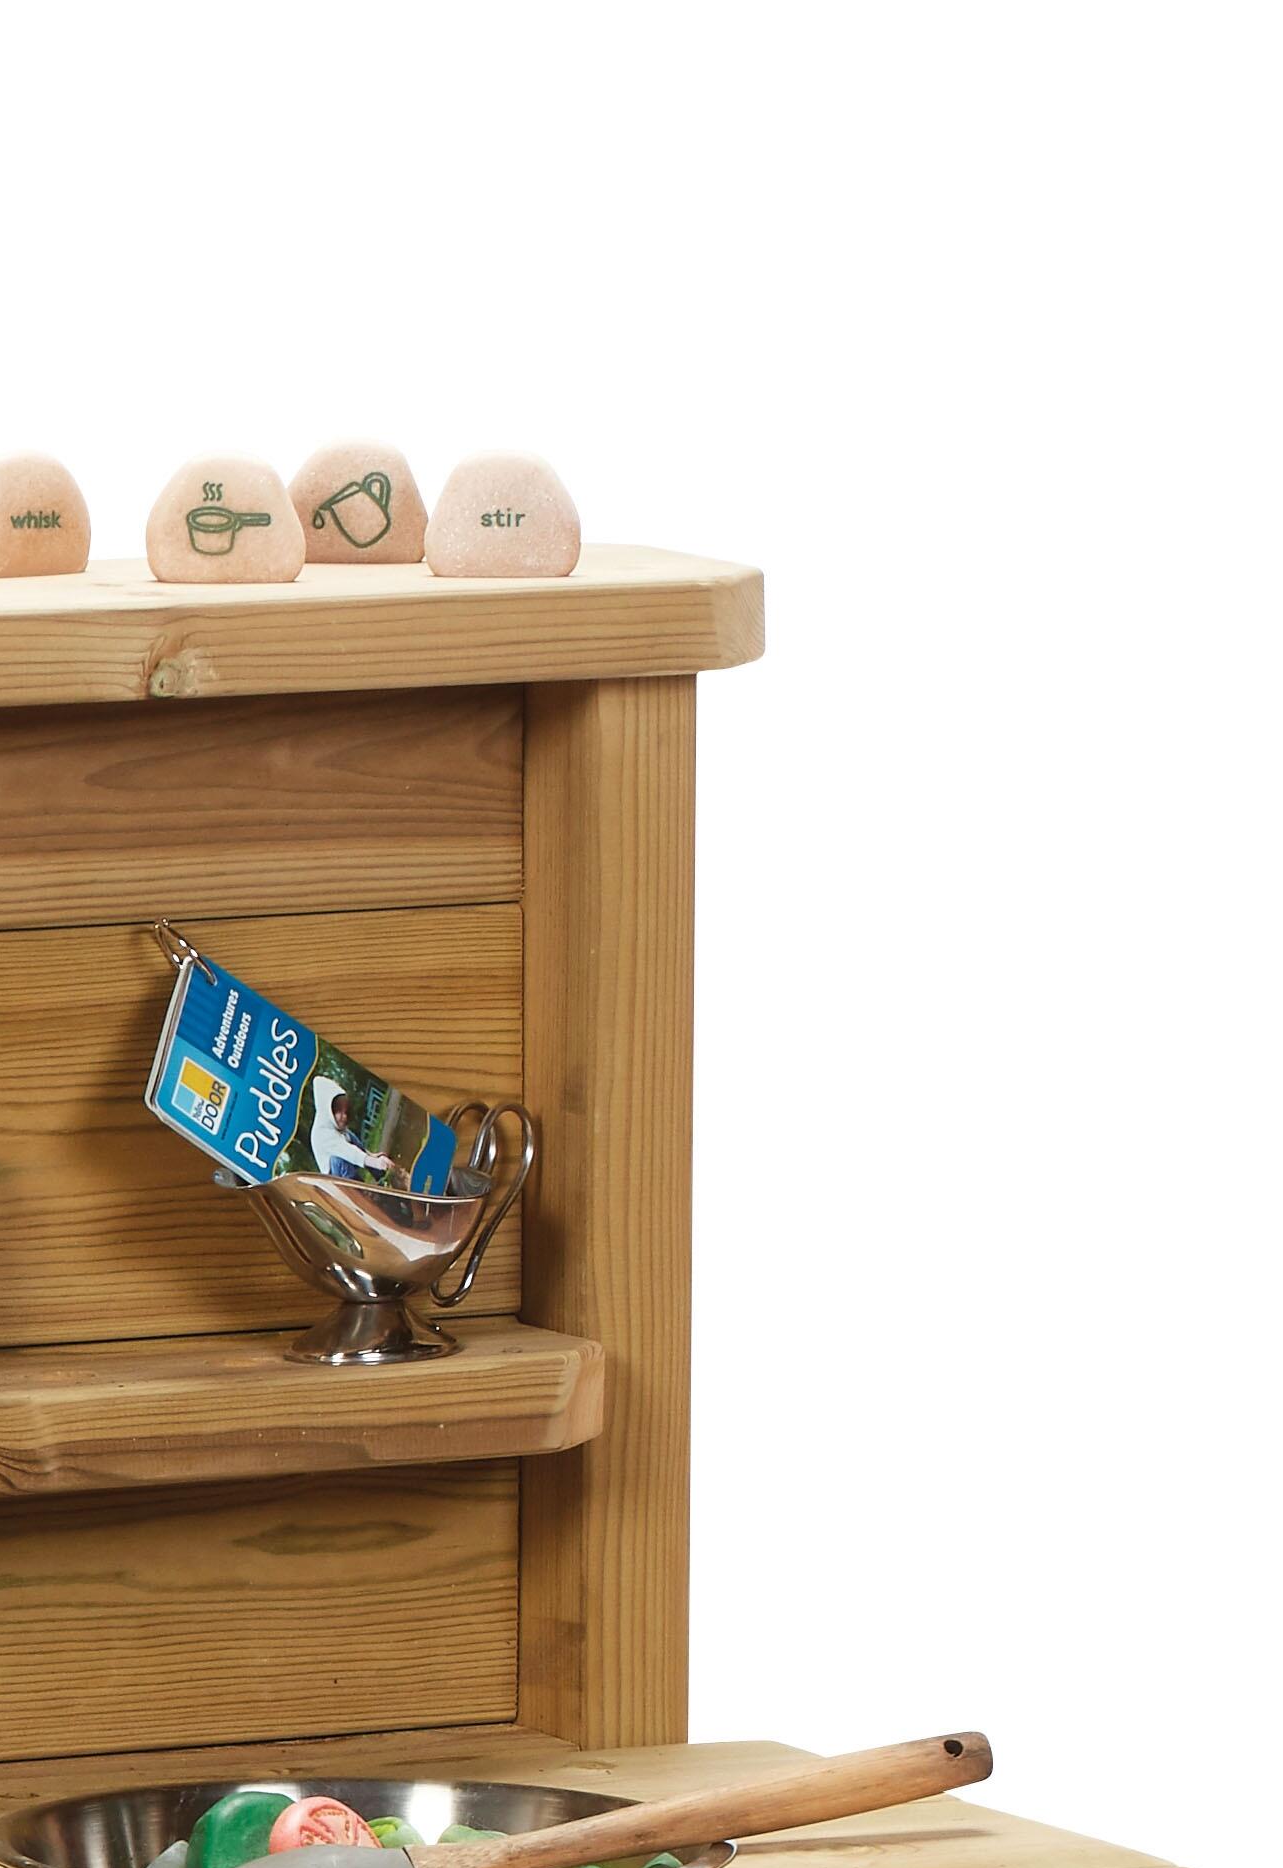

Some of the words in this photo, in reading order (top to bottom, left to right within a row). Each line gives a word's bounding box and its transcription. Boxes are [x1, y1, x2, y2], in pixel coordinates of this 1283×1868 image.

[10, 509, 61, 529] whisk
[480, 507, 526, 528] stir
[211, 989, 239, 1059] Adventures
[227, 1011, 252, 1069] Outdoors
[201, 1080, 227, 1130] DOOR
[235, 1017, 299, 1169] Puddles
